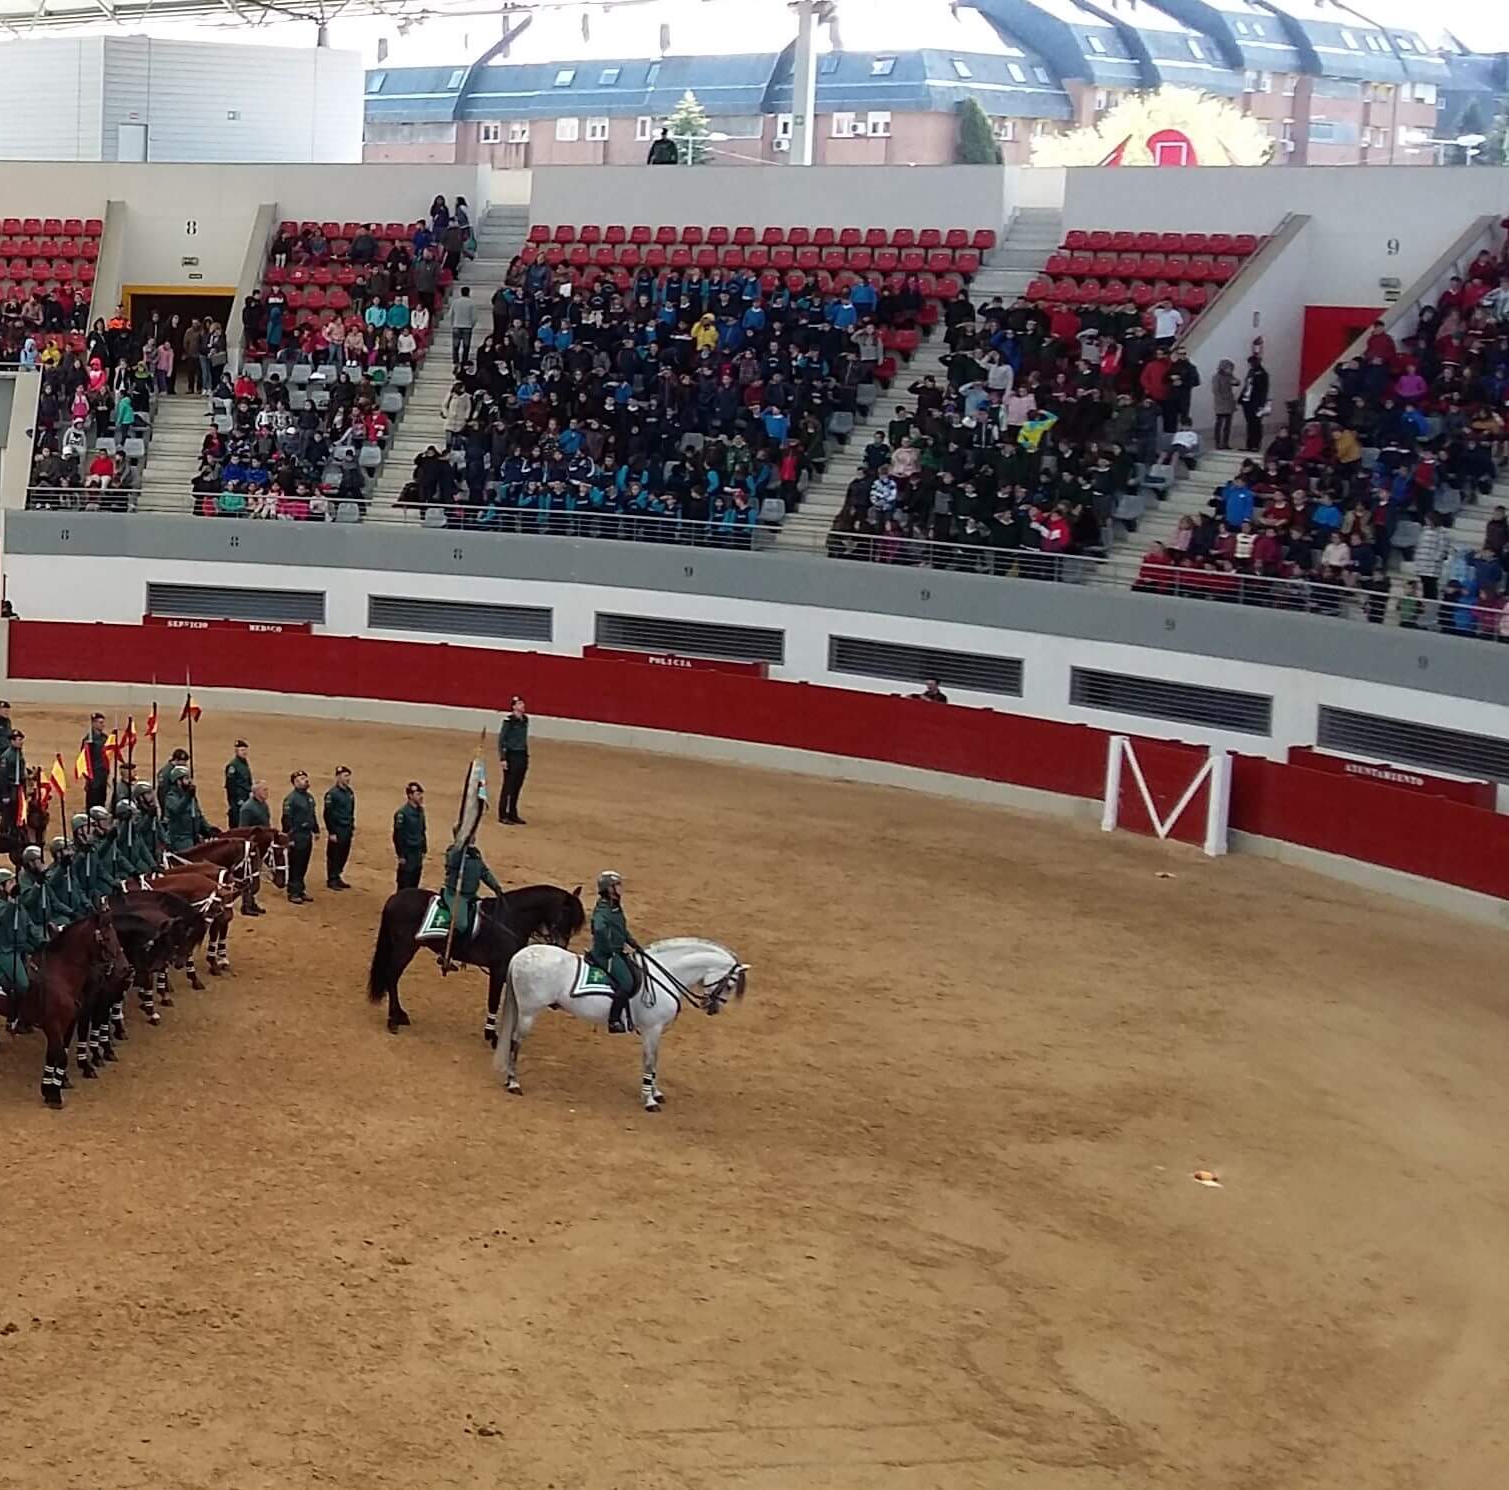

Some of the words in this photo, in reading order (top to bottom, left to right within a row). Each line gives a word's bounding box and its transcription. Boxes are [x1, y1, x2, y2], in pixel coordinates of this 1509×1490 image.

[186, 220, 198, 236] 8
[1387, 238, 1400, 255] 9
[61, 529, 70, 540] 8
[230, 536, 239, 547] 8
[453, 548, 463, 560] 8
[167, 620, 208, 629] SERVICIO
[249, 624, 282, 633] MEDICO
[649, 656, 692, 668] POLICIA
[1344, 763, 1424, 786] AYUNTAMIENTO
